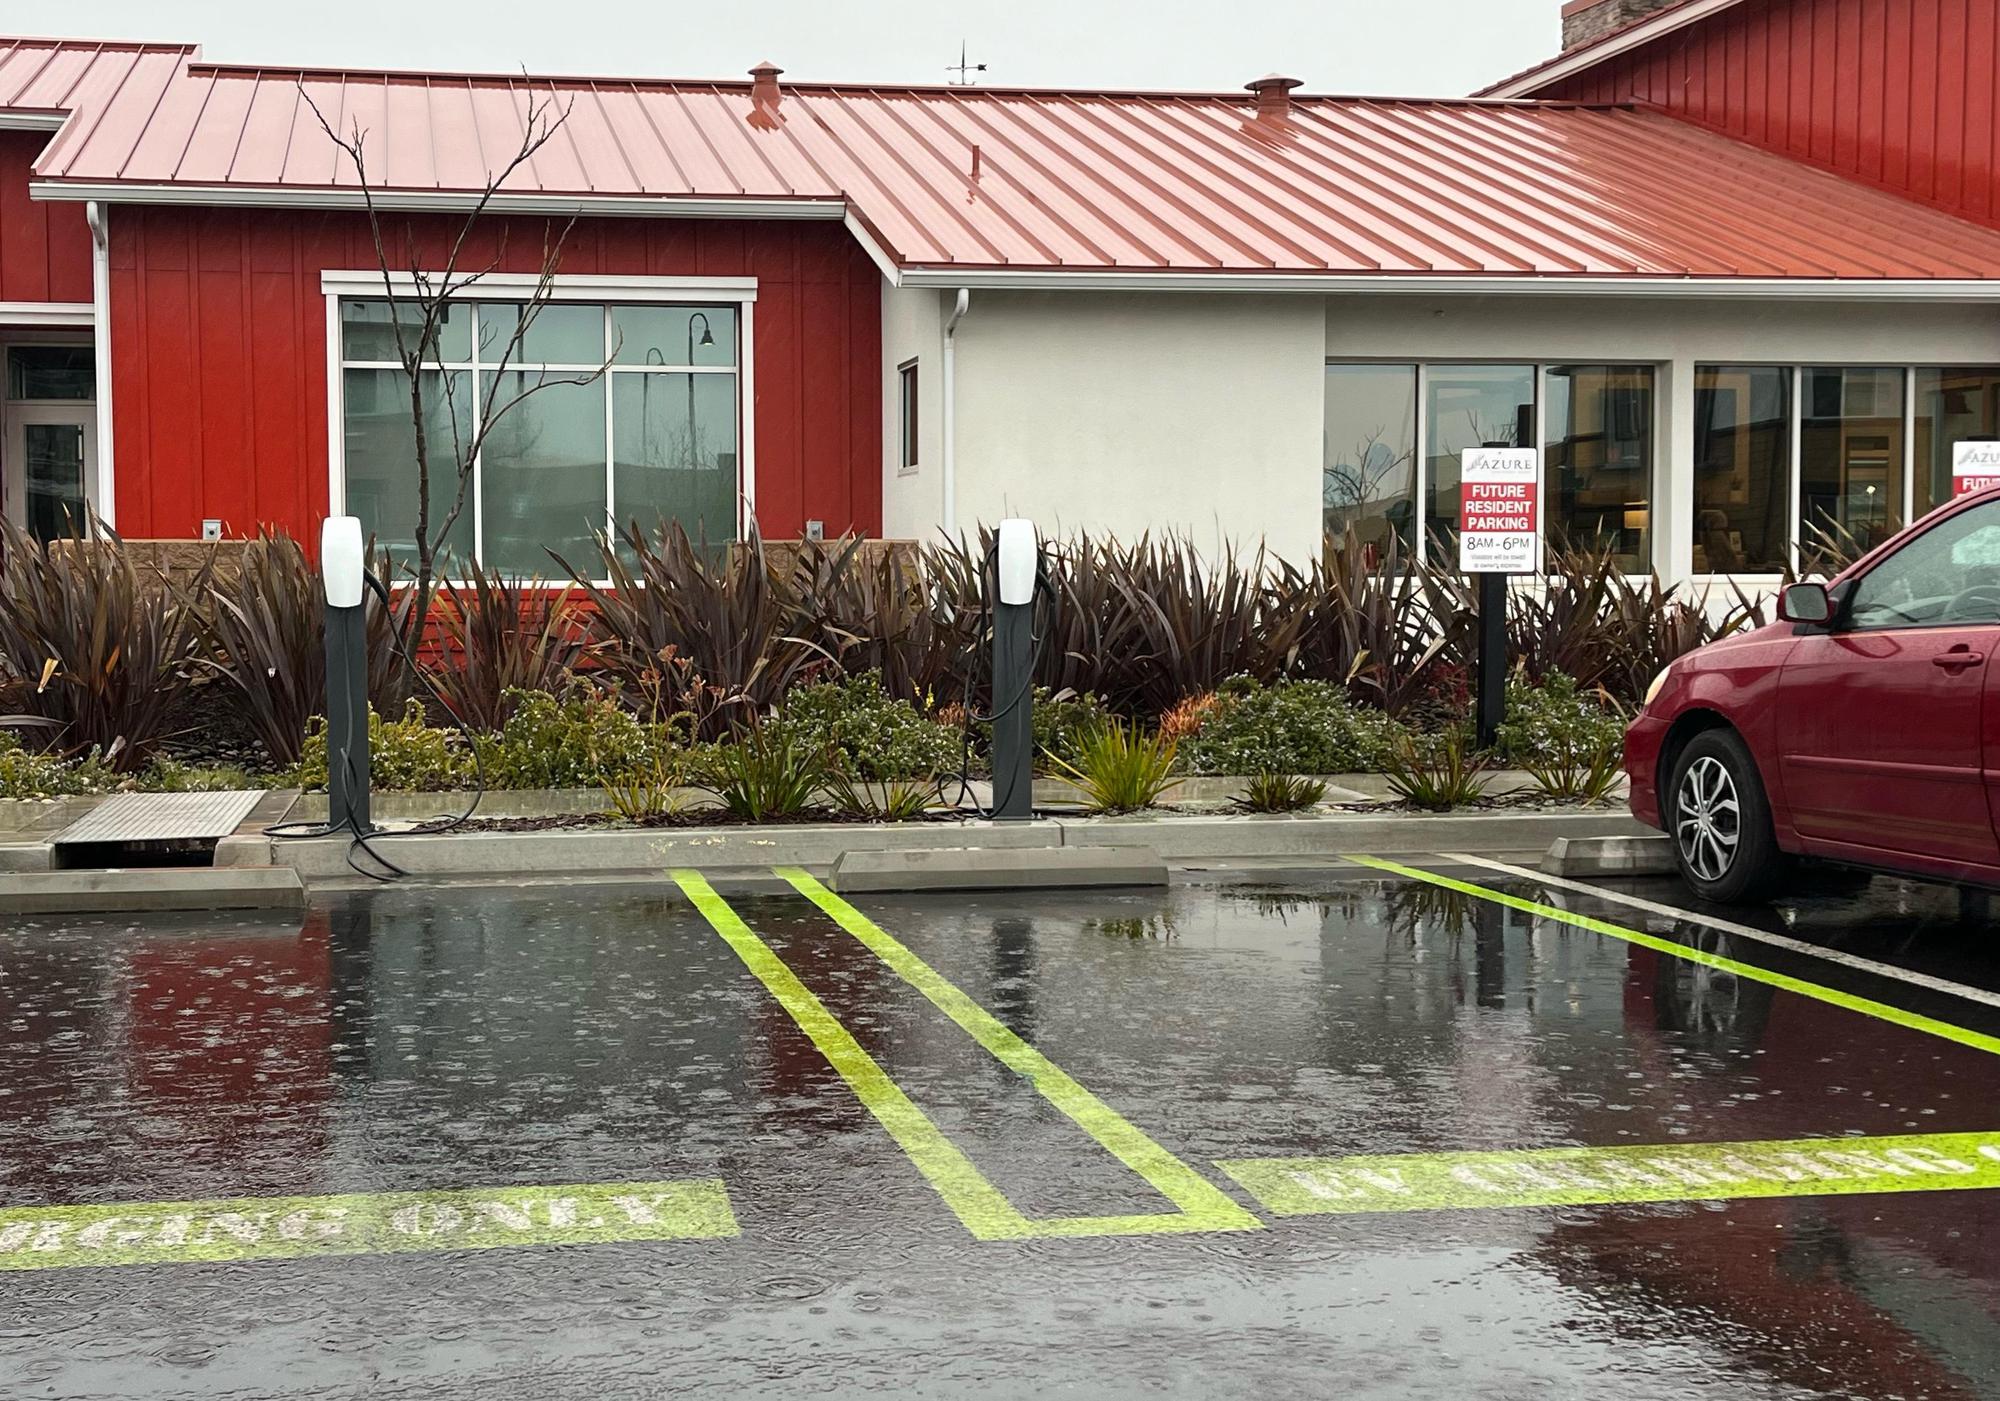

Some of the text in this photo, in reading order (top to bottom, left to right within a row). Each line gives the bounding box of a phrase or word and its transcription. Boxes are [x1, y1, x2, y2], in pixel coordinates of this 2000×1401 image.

[1480, 459, 1533, 470] AZURE
[1472, 485, 1526, 498] FUTURE
[1465, 501, 1532, 513] RESIDENT
[1468, 517, 1529, 529] PARKING
[392, 1193, 672, 1234] ONLY
